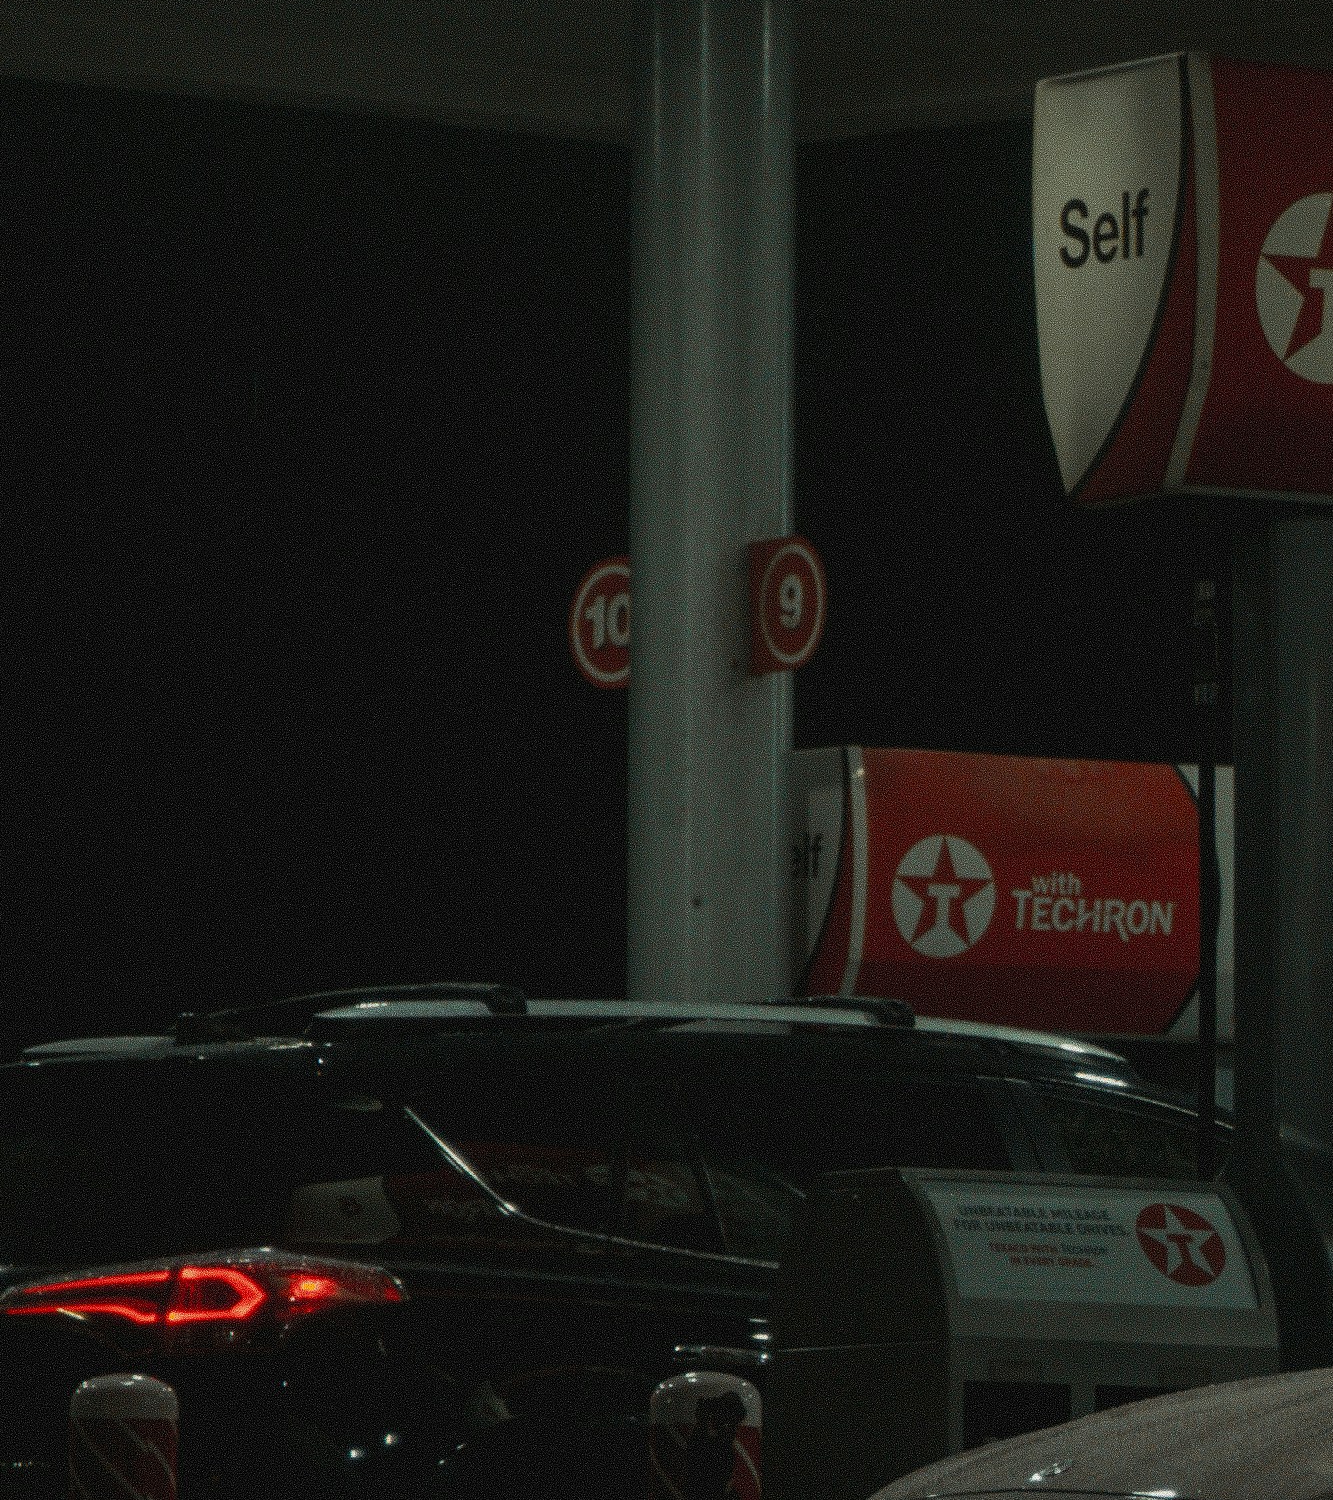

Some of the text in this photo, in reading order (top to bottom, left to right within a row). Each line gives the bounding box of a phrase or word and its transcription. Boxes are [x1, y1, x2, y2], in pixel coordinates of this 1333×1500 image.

[1058, 188, 1150, 269] Self
[584, 592, 630, 650] 10
[778, 573, 804, 629] 9
[1031, 870, 1081, 897] with
[1011, 889, 1175, 943] TECHRON
[953, 1219, 983, 1231] FOR
[985, 1220, 1075, 1234] UNBEATABLE
